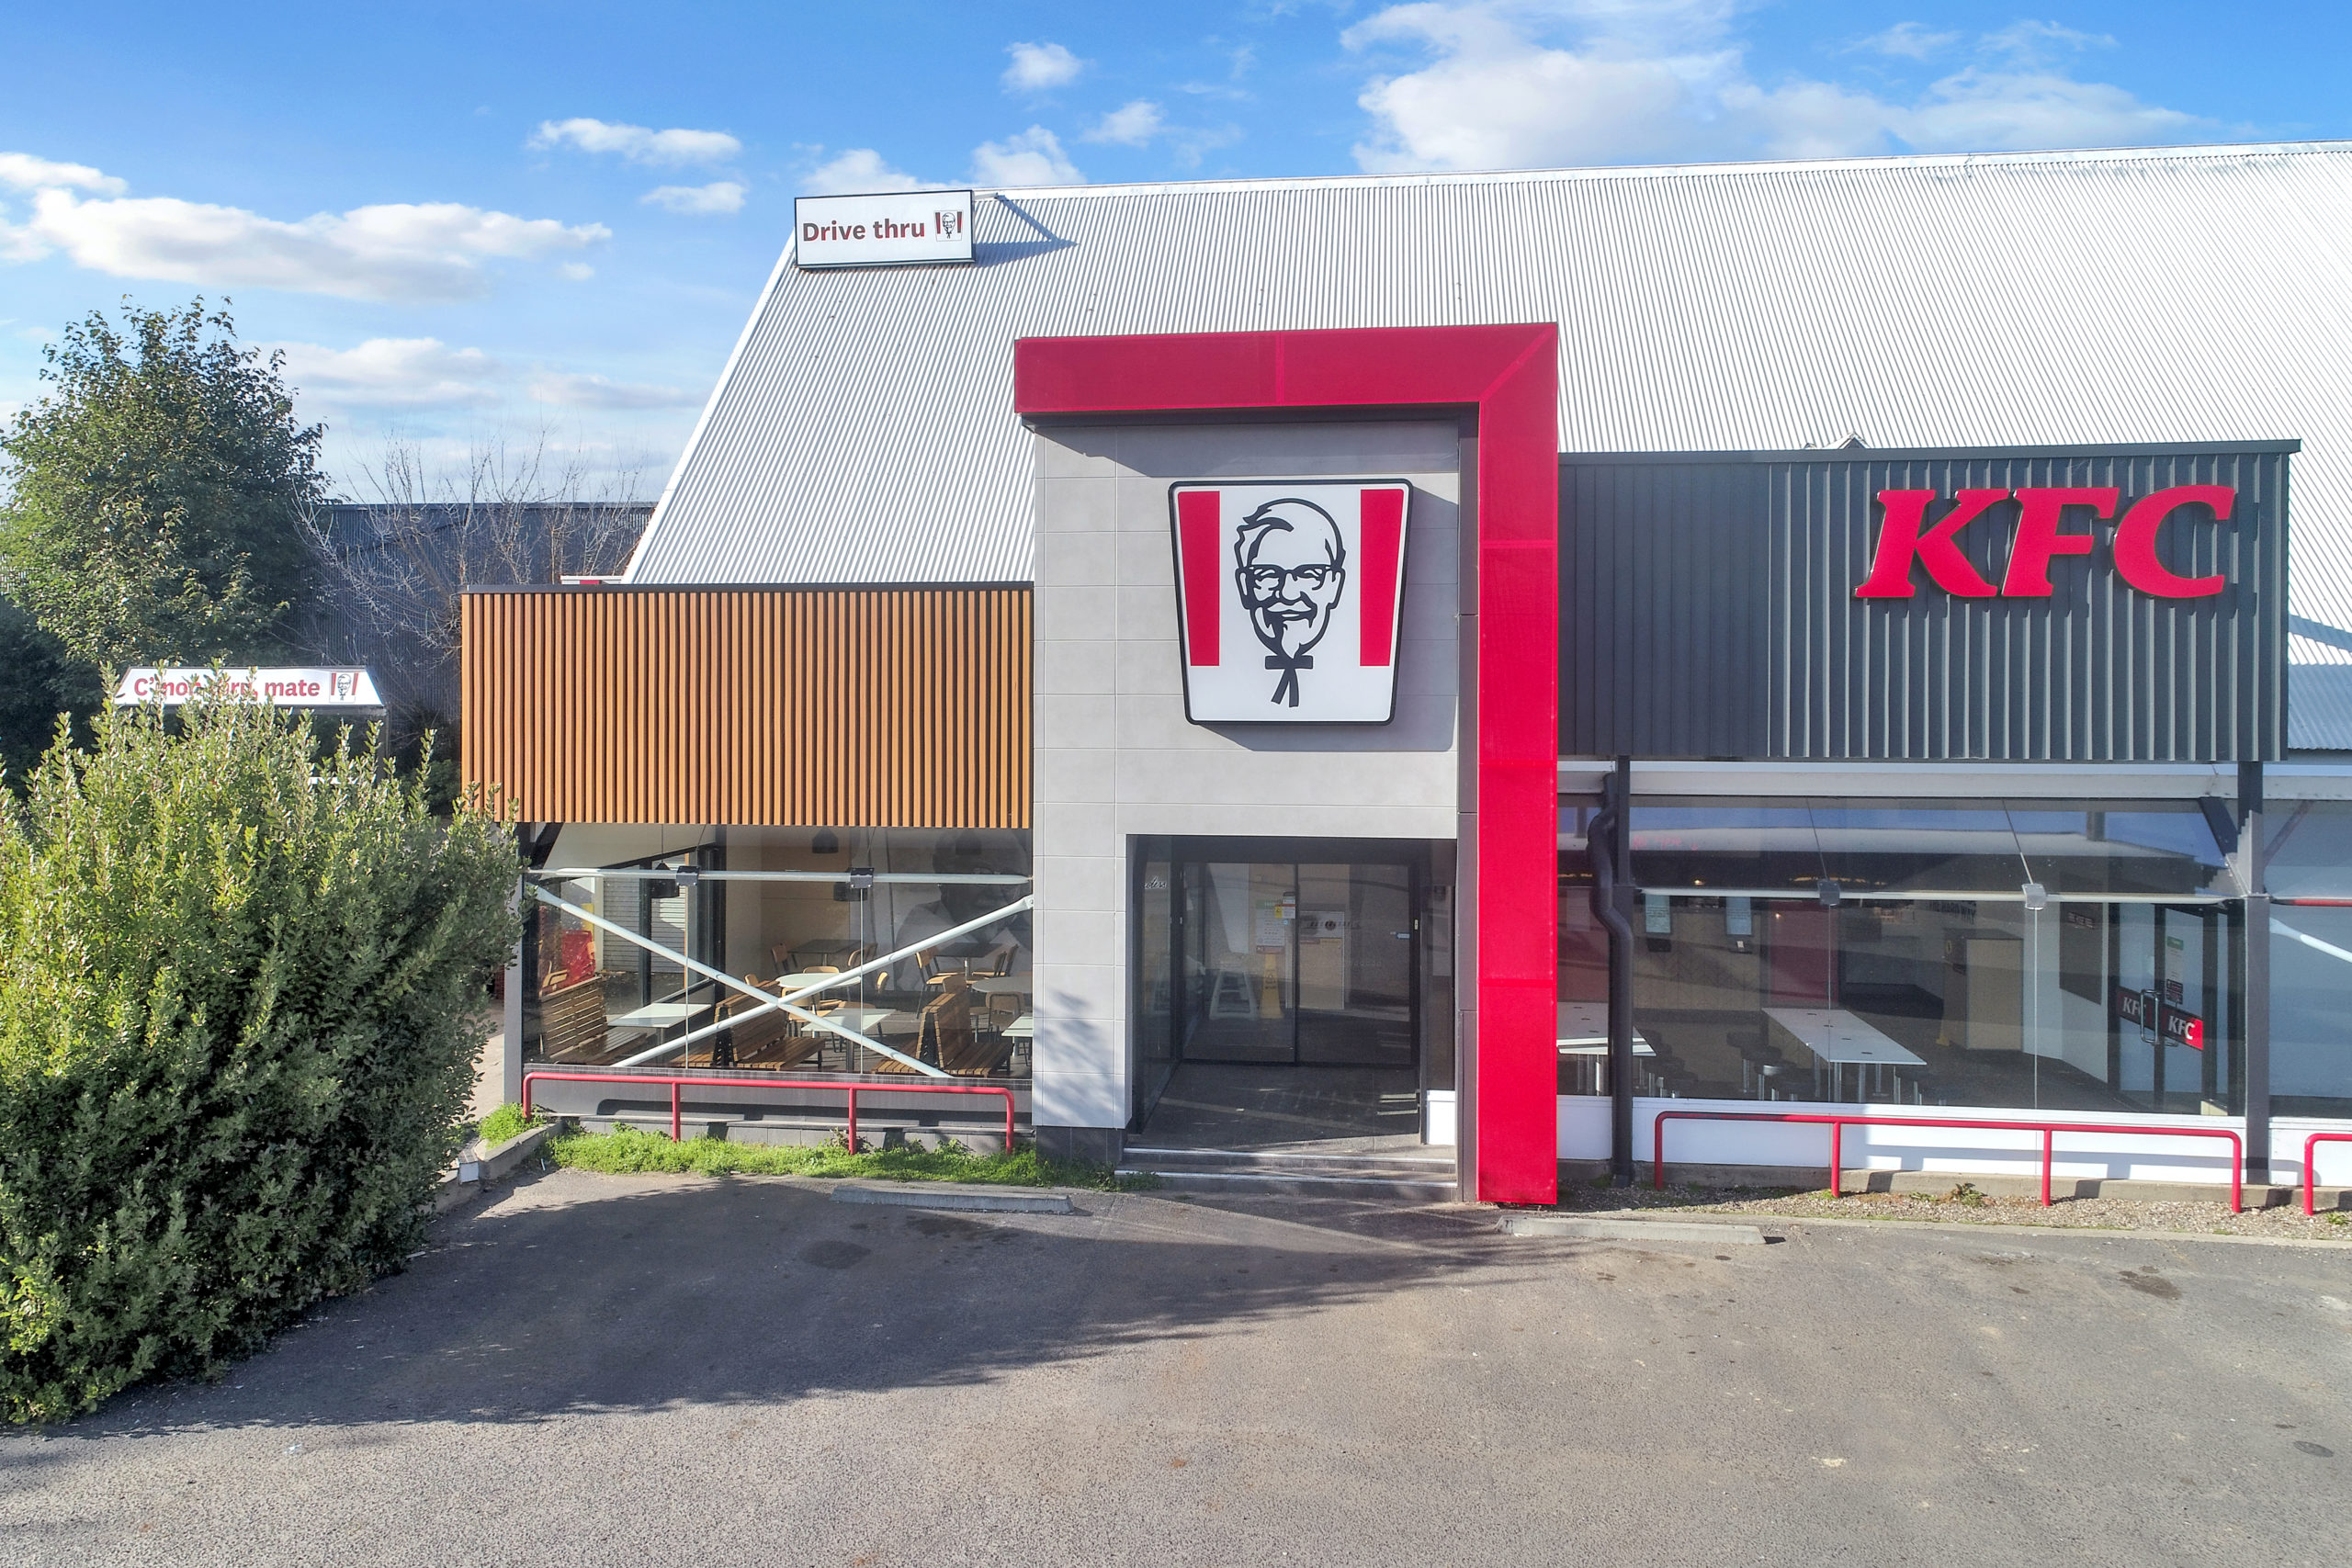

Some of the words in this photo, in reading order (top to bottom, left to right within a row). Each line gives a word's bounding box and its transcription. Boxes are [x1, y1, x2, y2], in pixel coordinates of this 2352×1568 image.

[802, 220, 865, 242] Drive
[873, 218, 925, 239] thru
[1852, 484, 2236, 599] KFC
[264, 678, 321, 697] mate
[2168, 1015, 2196, 1041] KFC
